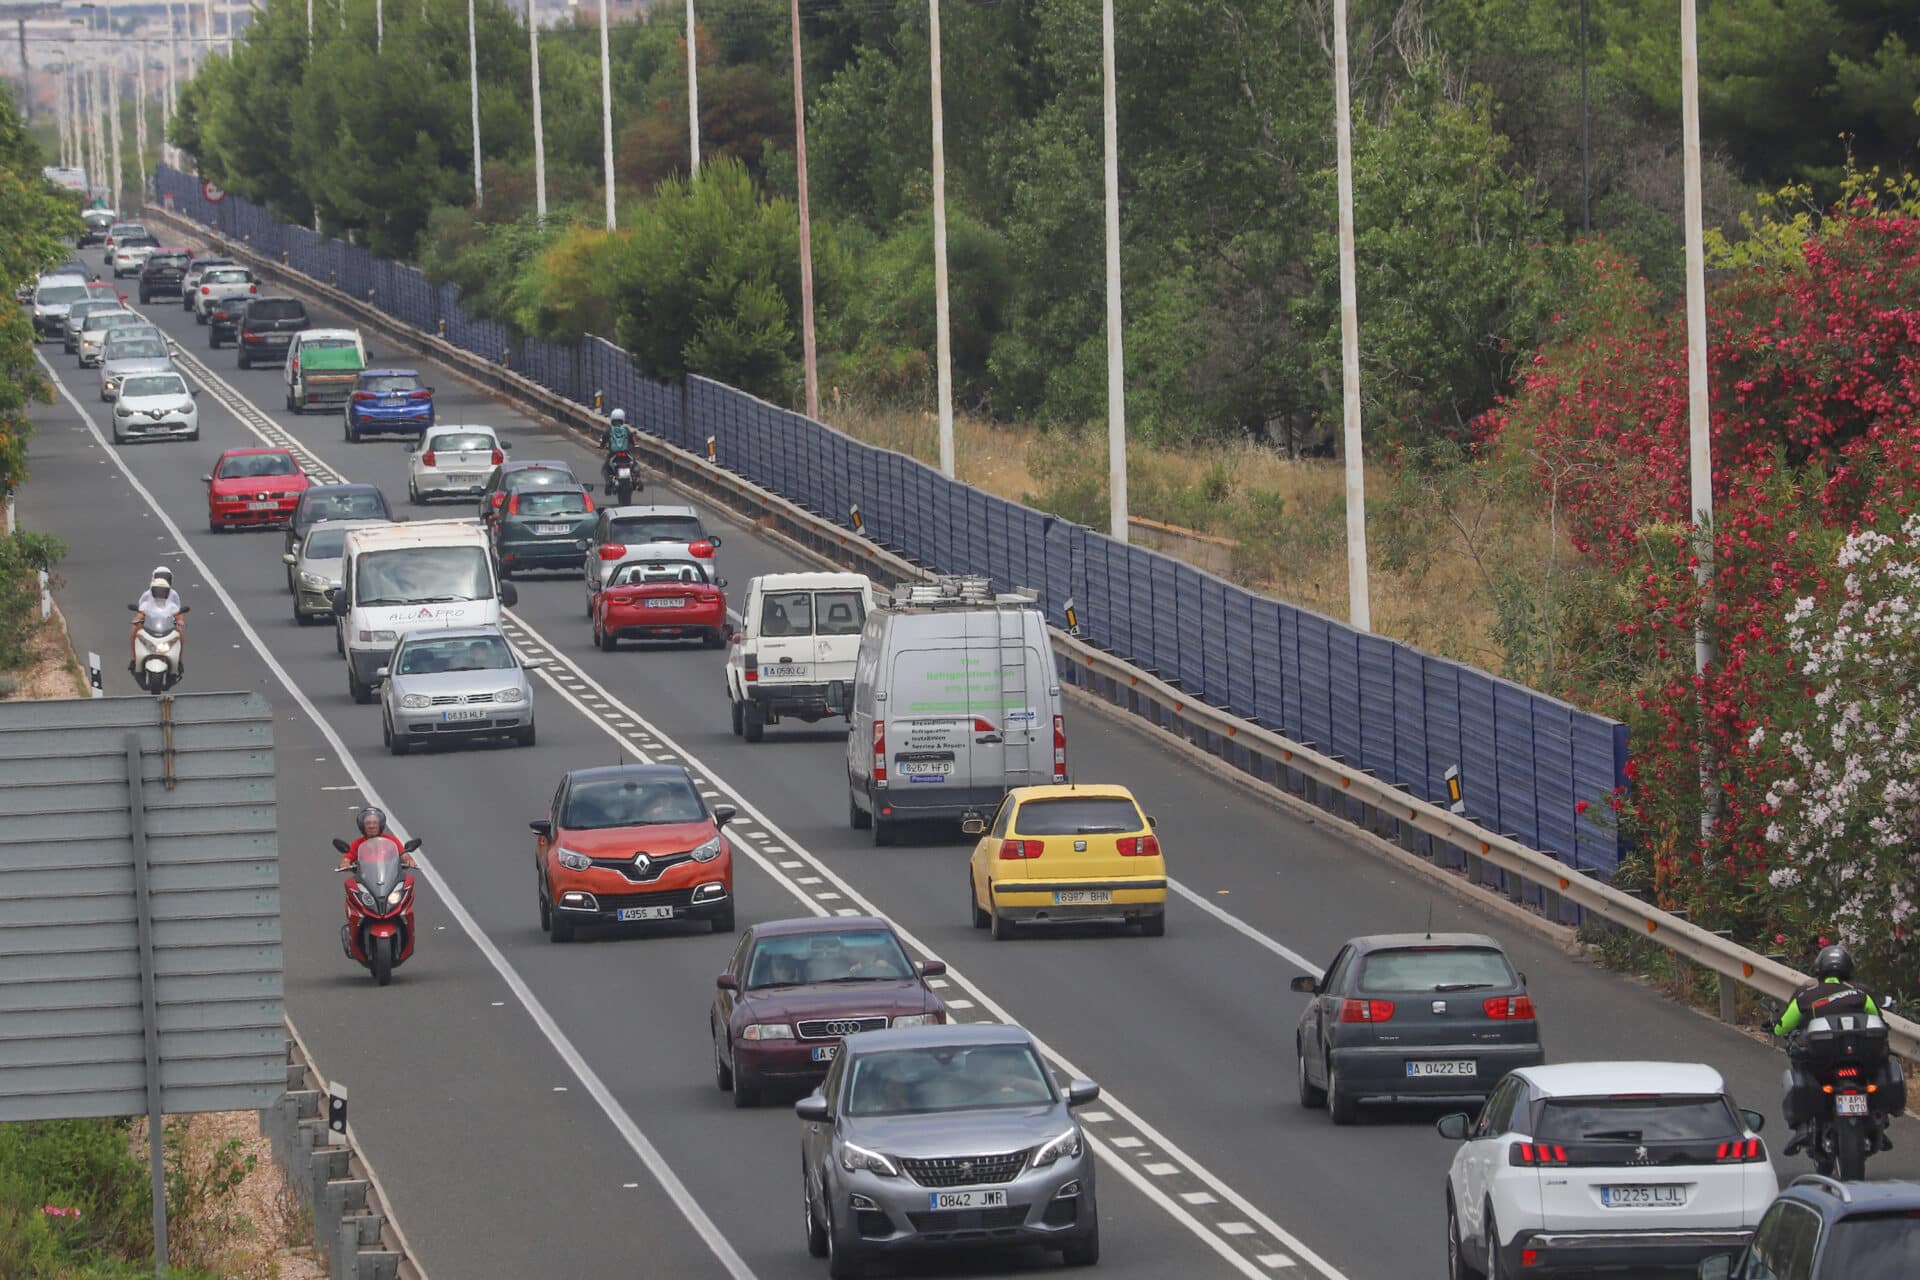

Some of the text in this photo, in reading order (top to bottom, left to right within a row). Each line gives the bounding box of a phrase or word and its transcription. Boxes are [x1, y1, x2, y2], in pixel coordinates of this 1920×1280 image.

[1090, 891, 1109, 902] BHN
[1414, 1062, 1473, 1074] A 0422 EG
[940, 1191, 1003, 1208] 0842 JWR
[1612, 1187, 1682, 1202] 0225 LJL
